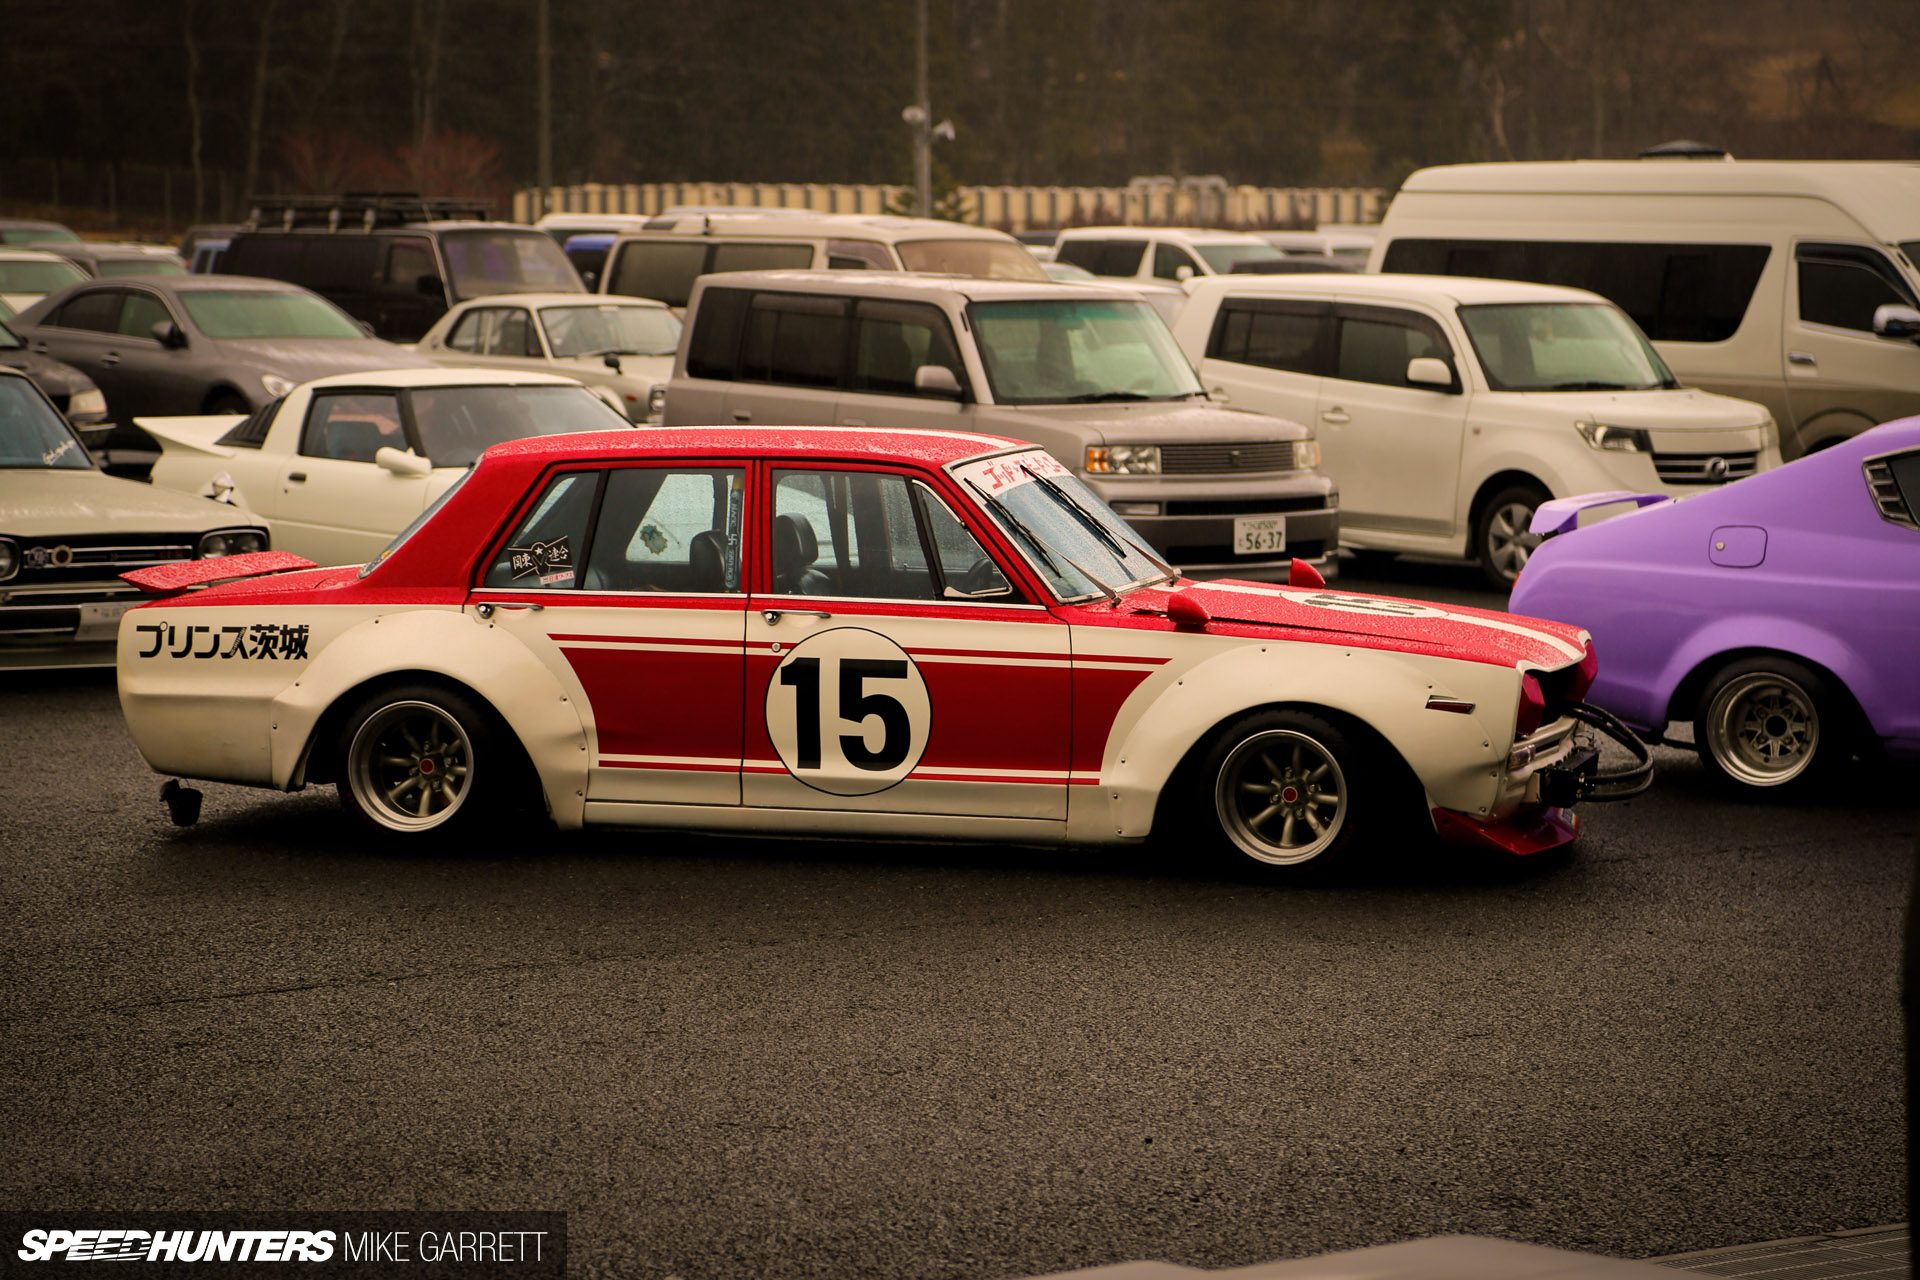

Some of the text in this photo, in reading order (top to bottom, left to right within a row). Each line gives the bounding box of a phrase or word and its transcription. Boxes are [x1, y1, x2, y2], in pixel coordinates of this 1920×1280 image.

[136, 620, 309, 660] プリンス茨城
[780, 657, 911, 772] 15
